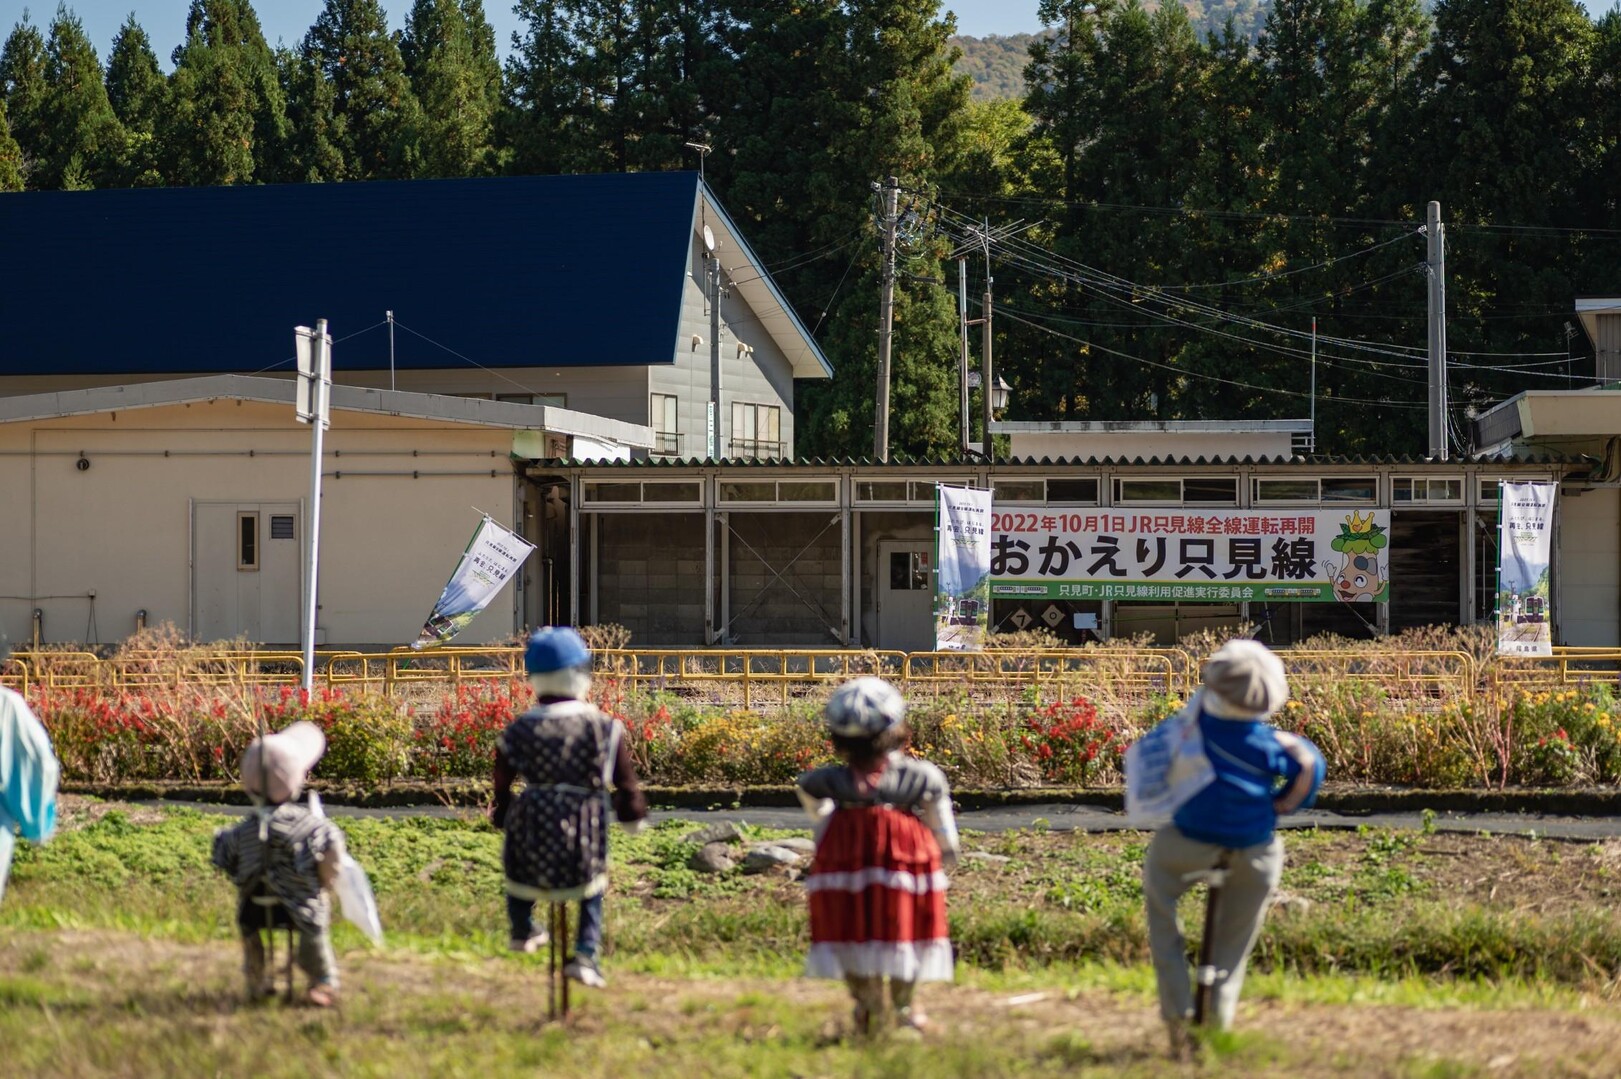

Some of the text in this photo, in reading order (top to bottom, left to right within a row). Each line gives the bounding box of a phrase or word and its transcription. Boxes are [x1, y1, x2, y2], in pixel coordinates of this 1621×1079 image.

[990, 534, 1317, 580] おかえり只見線
